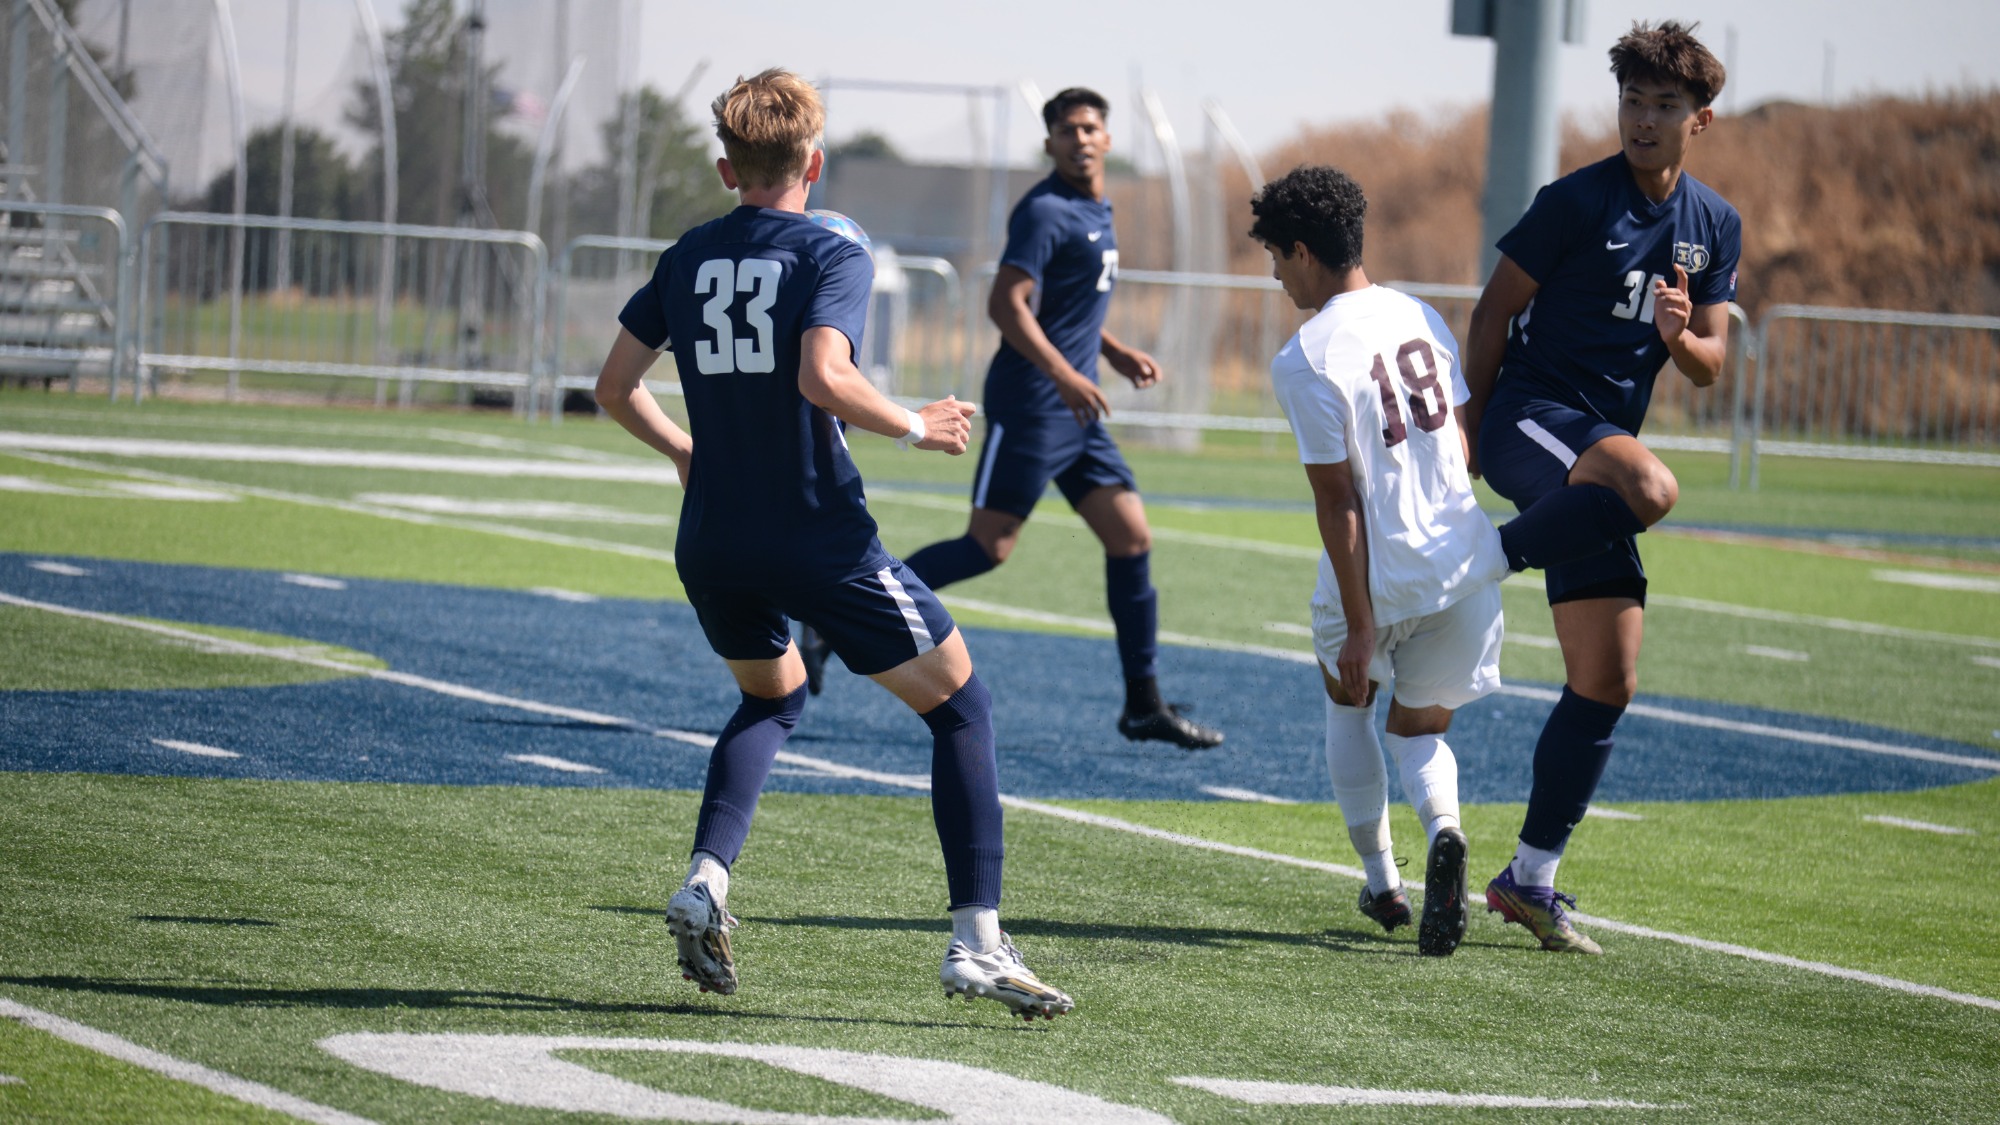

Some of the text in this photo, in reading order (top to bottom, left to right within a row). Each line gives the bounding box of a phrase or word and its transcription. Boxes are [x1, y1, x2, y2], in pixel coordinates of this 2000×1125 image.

[694, 258, 783, 375] 33
[1611, 270, 1665, 324] 31
[1369, 337, 1448, 448] 18
